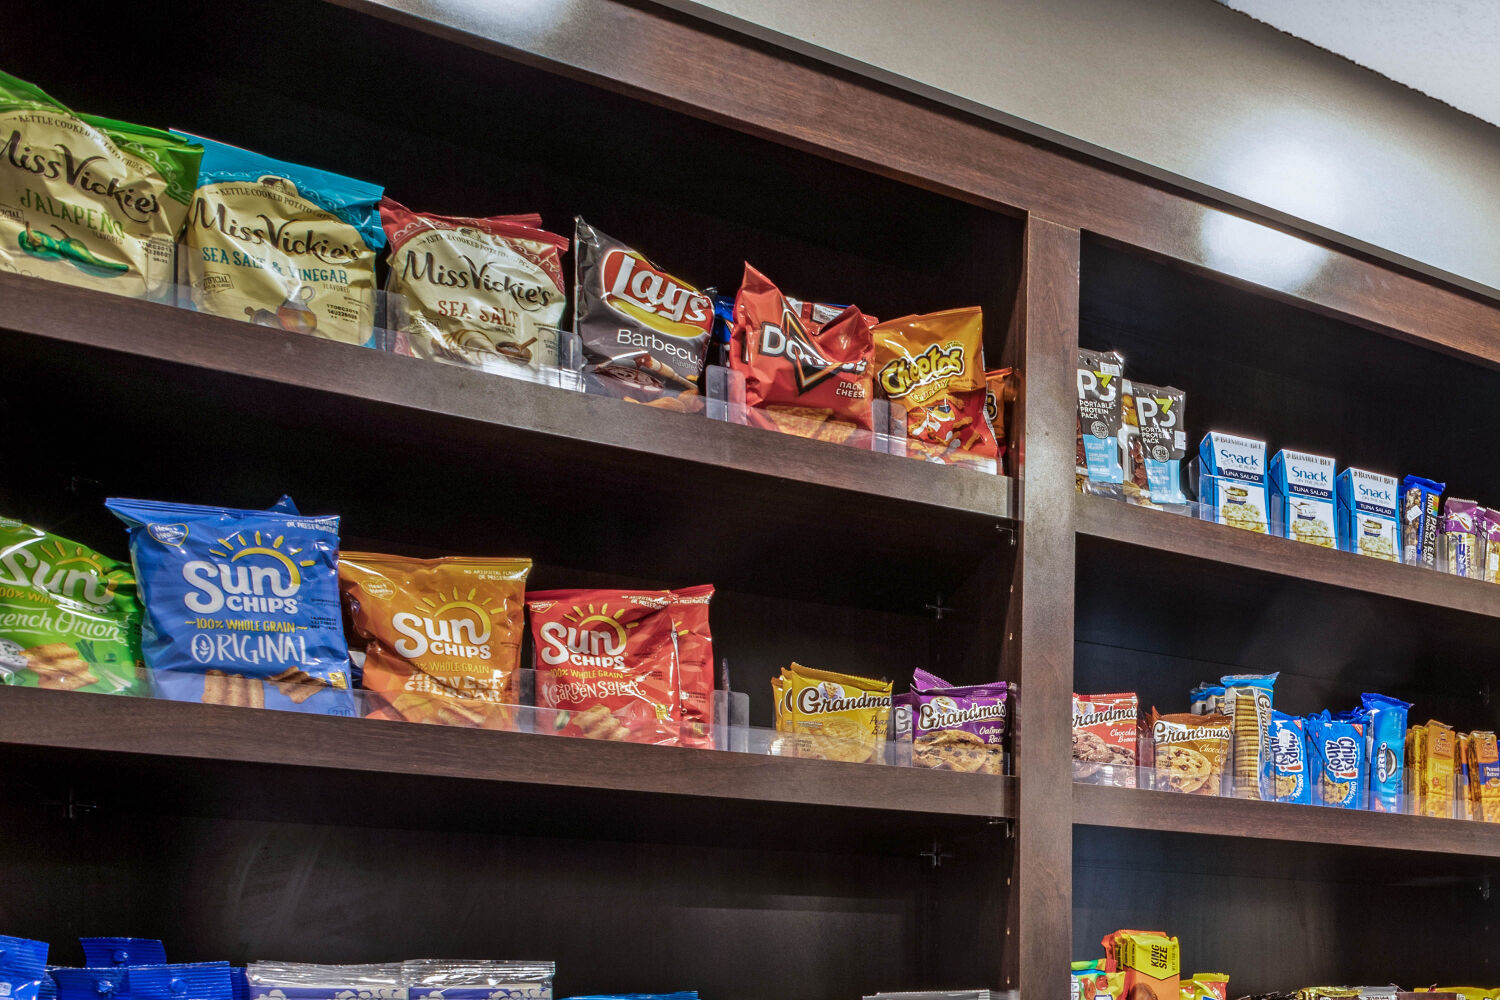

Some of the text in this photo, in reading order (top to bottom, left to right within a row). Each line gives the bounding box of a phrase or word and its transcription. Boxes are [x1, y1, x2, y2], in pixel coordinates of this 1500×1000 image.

[193, 197, 264, 245] Miss
[202, 247, 349, 285] SEA SALT VINEGAR
[402, 250, 468, 288] Miss
[458, 255, 552, 312] Vickie's
[610, 253, 711, 324] Lay's
[438, 300, 519, 328] SEA SALT
[879, 348, 963, 398] Cheetos
[1077, 369, 1117, 401] P3
[1079, 400, 1114, 410] PORTABLE
[1080, 407, 1109, 416] PROTEIN
[1135, 397, 1177, 428] P3
[1142, 437, 1160, 445] PACK
[1220, 449, 1259, 467] Snack
[1239, 472, 1259, 482] SALAD
[1291, 466, 1328, 483] Snack
[1293, 485, 1328, 498] TUNA SALAD
[1358, 483, 1391, 501] Snack
[1359, 503, 1391, 516] TUNA SALAD
[1426, 493, 1437, 566] KIND PROTEIN
[0, 545, 114, 605] Sun
[182, 560, 300, 614] Sun
[225, 595, 299, 615] CHIPS
[55, 611, 121, 639] Onion
[196, 618, 225, 630] 100%
[225, 618, 261, 632] WHOLE
[263, 620, 297, 634] GRAIN
[392, 611, 492, 660] Sun
[191, 632, 320, 666] ORIGINAL
[430, 642, 492, 660] CHIPS
[540, 621, 628, 665] Sun
[430, 661, 491, 674] WHOLE GRAIN
[569, 654, 626, 669] CHIPS
[570, 668, 624, 680] WHOLE GRAIN
[918, 702, 1006, 731] Grandma's
[1153, 721, 1231, 746] Grandma's
[1338, 737, 1357, 772] Chips
[1377, 742, 1388, 784] OREO
[1150, 944, 1160, 968] KING
[1159, 946, 1168, 969] SIZE
